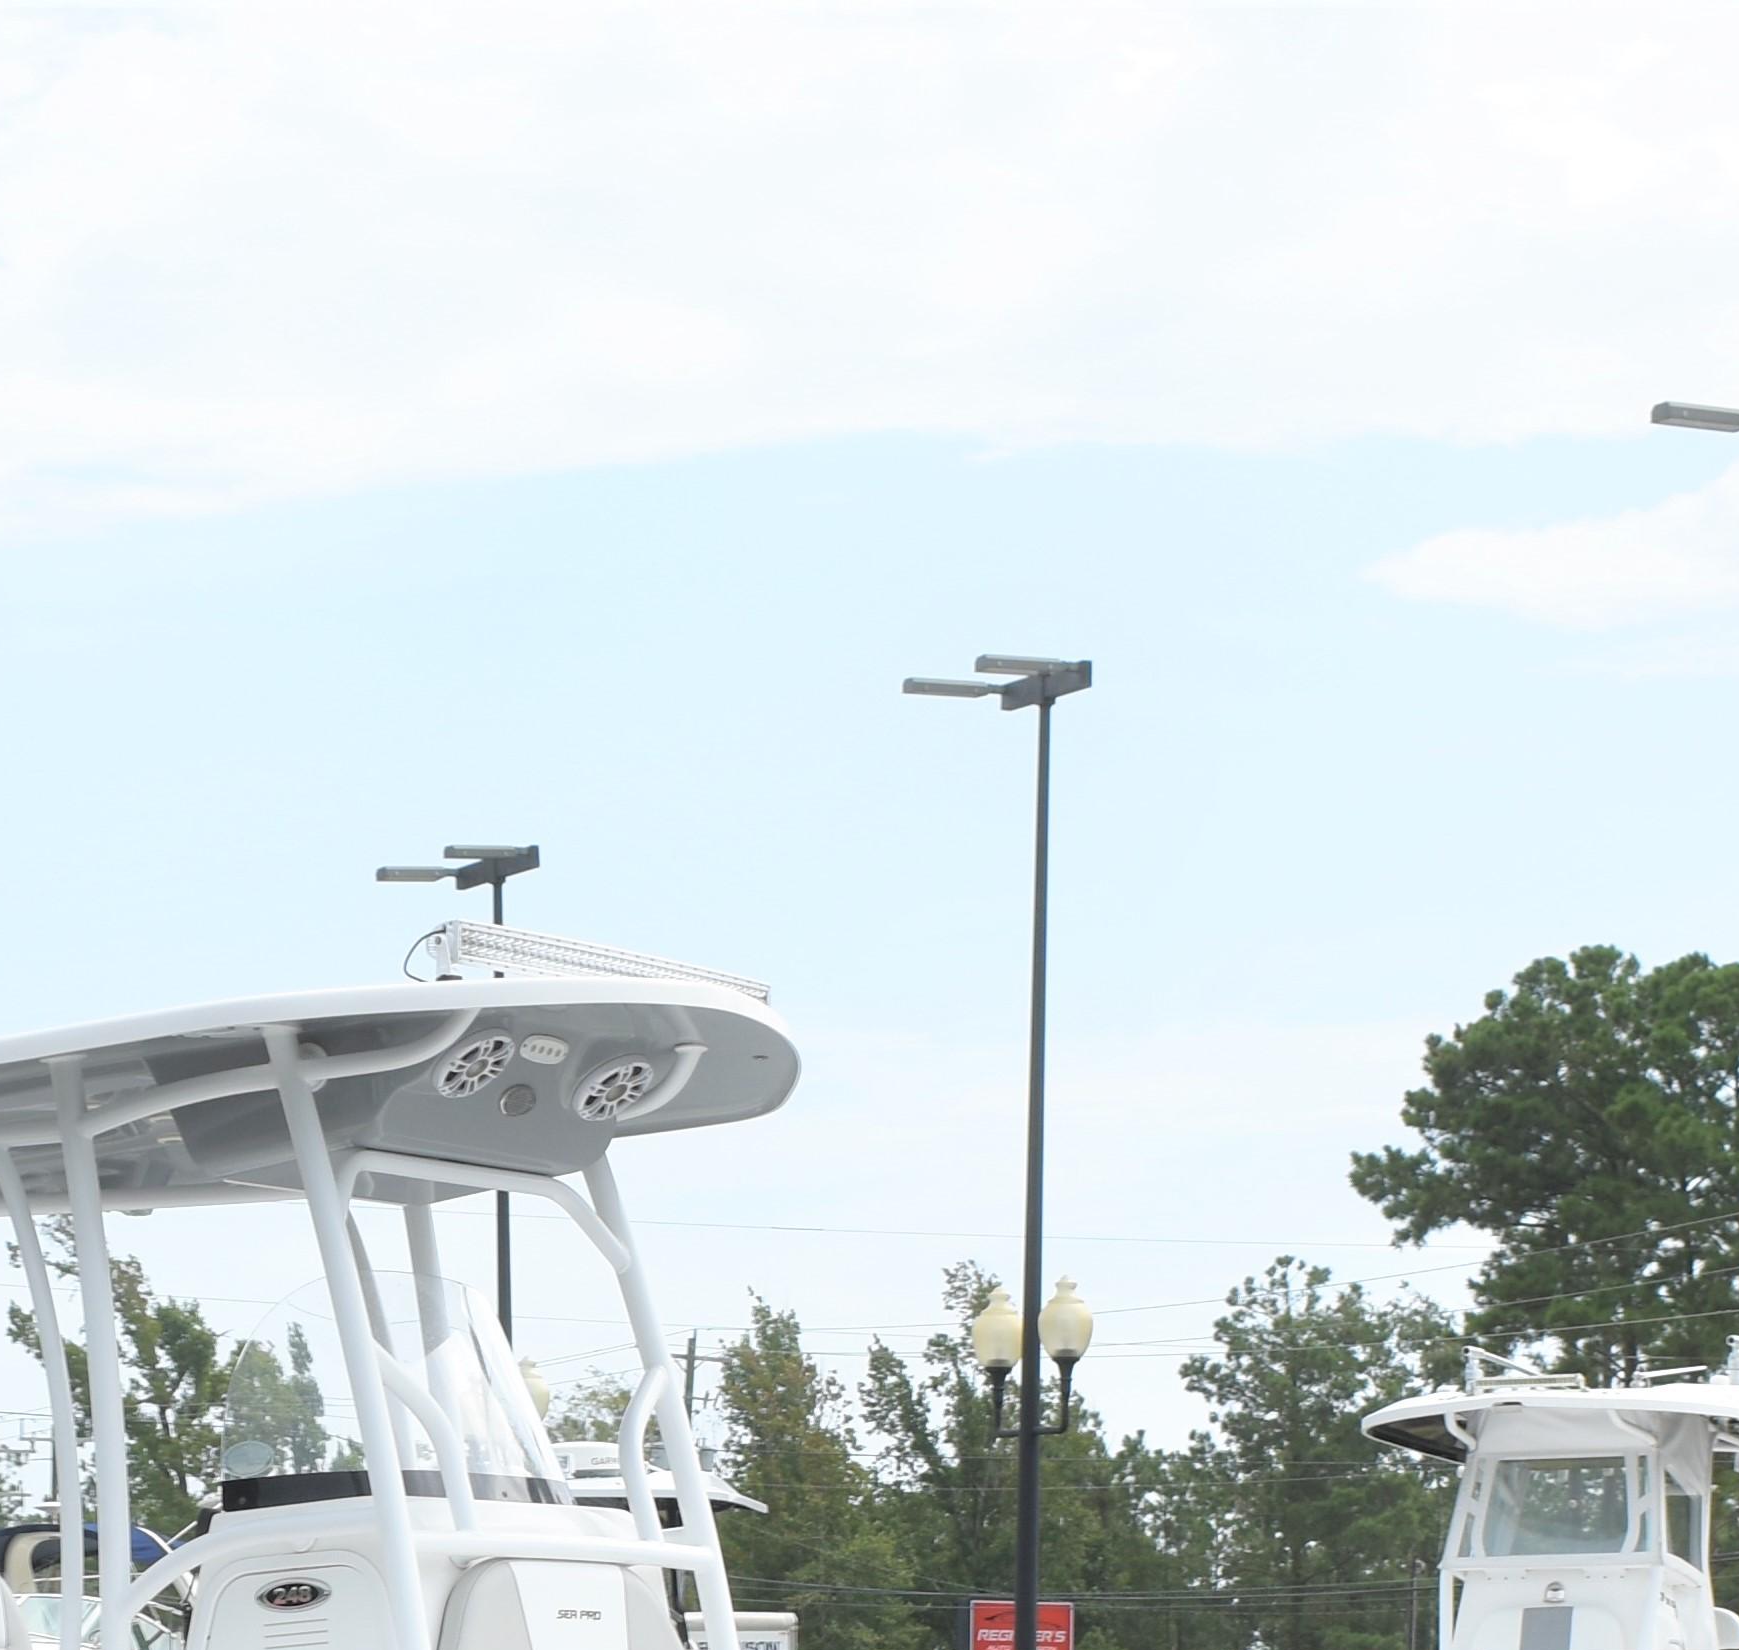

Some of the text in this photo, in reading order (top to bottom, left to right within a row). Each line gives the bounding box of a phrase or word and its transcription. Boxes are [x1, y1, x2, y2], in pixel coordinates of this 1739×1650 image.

[272, 1585, 312, 1605] 248
[556, 1609, 601, 1621] SEA PRO
